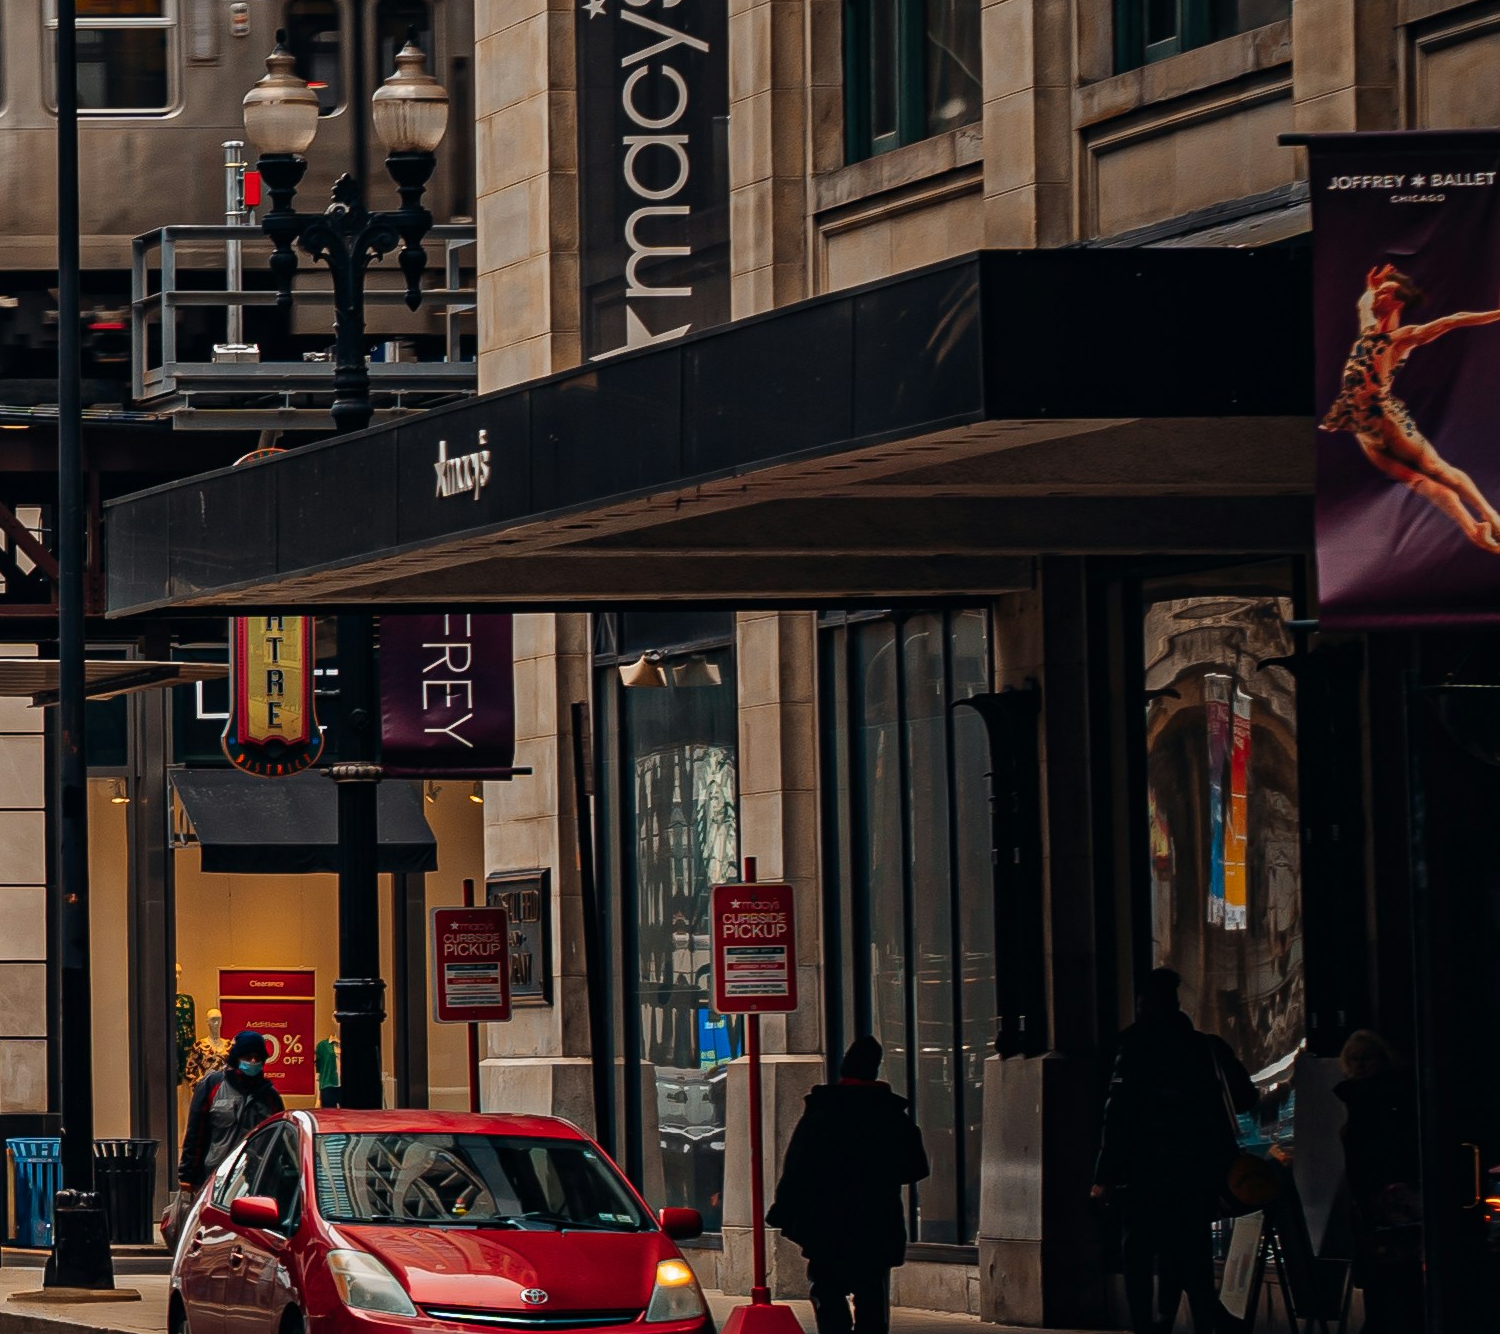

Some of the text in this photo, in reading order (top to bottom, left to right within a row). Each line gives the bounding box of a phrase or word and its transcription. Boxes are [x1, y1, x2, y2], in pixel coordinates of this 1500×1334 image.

[1327, 171, 1496, 190] JOFFREY BALLET
[1390, 194, 1446, 203] CHICAGO
[265, 617, 284, 728] ATRE
[722, 913, 787, 924] CURBSIDE
[723, 924, 788, 938] PICKUP
[443, 933, 500, 944] CURBSIDE
[444, 944, 501, 957] PICKUP
[249, 980, 285, 988] Clearance
[283, 1056, 304, 1065] OFF
